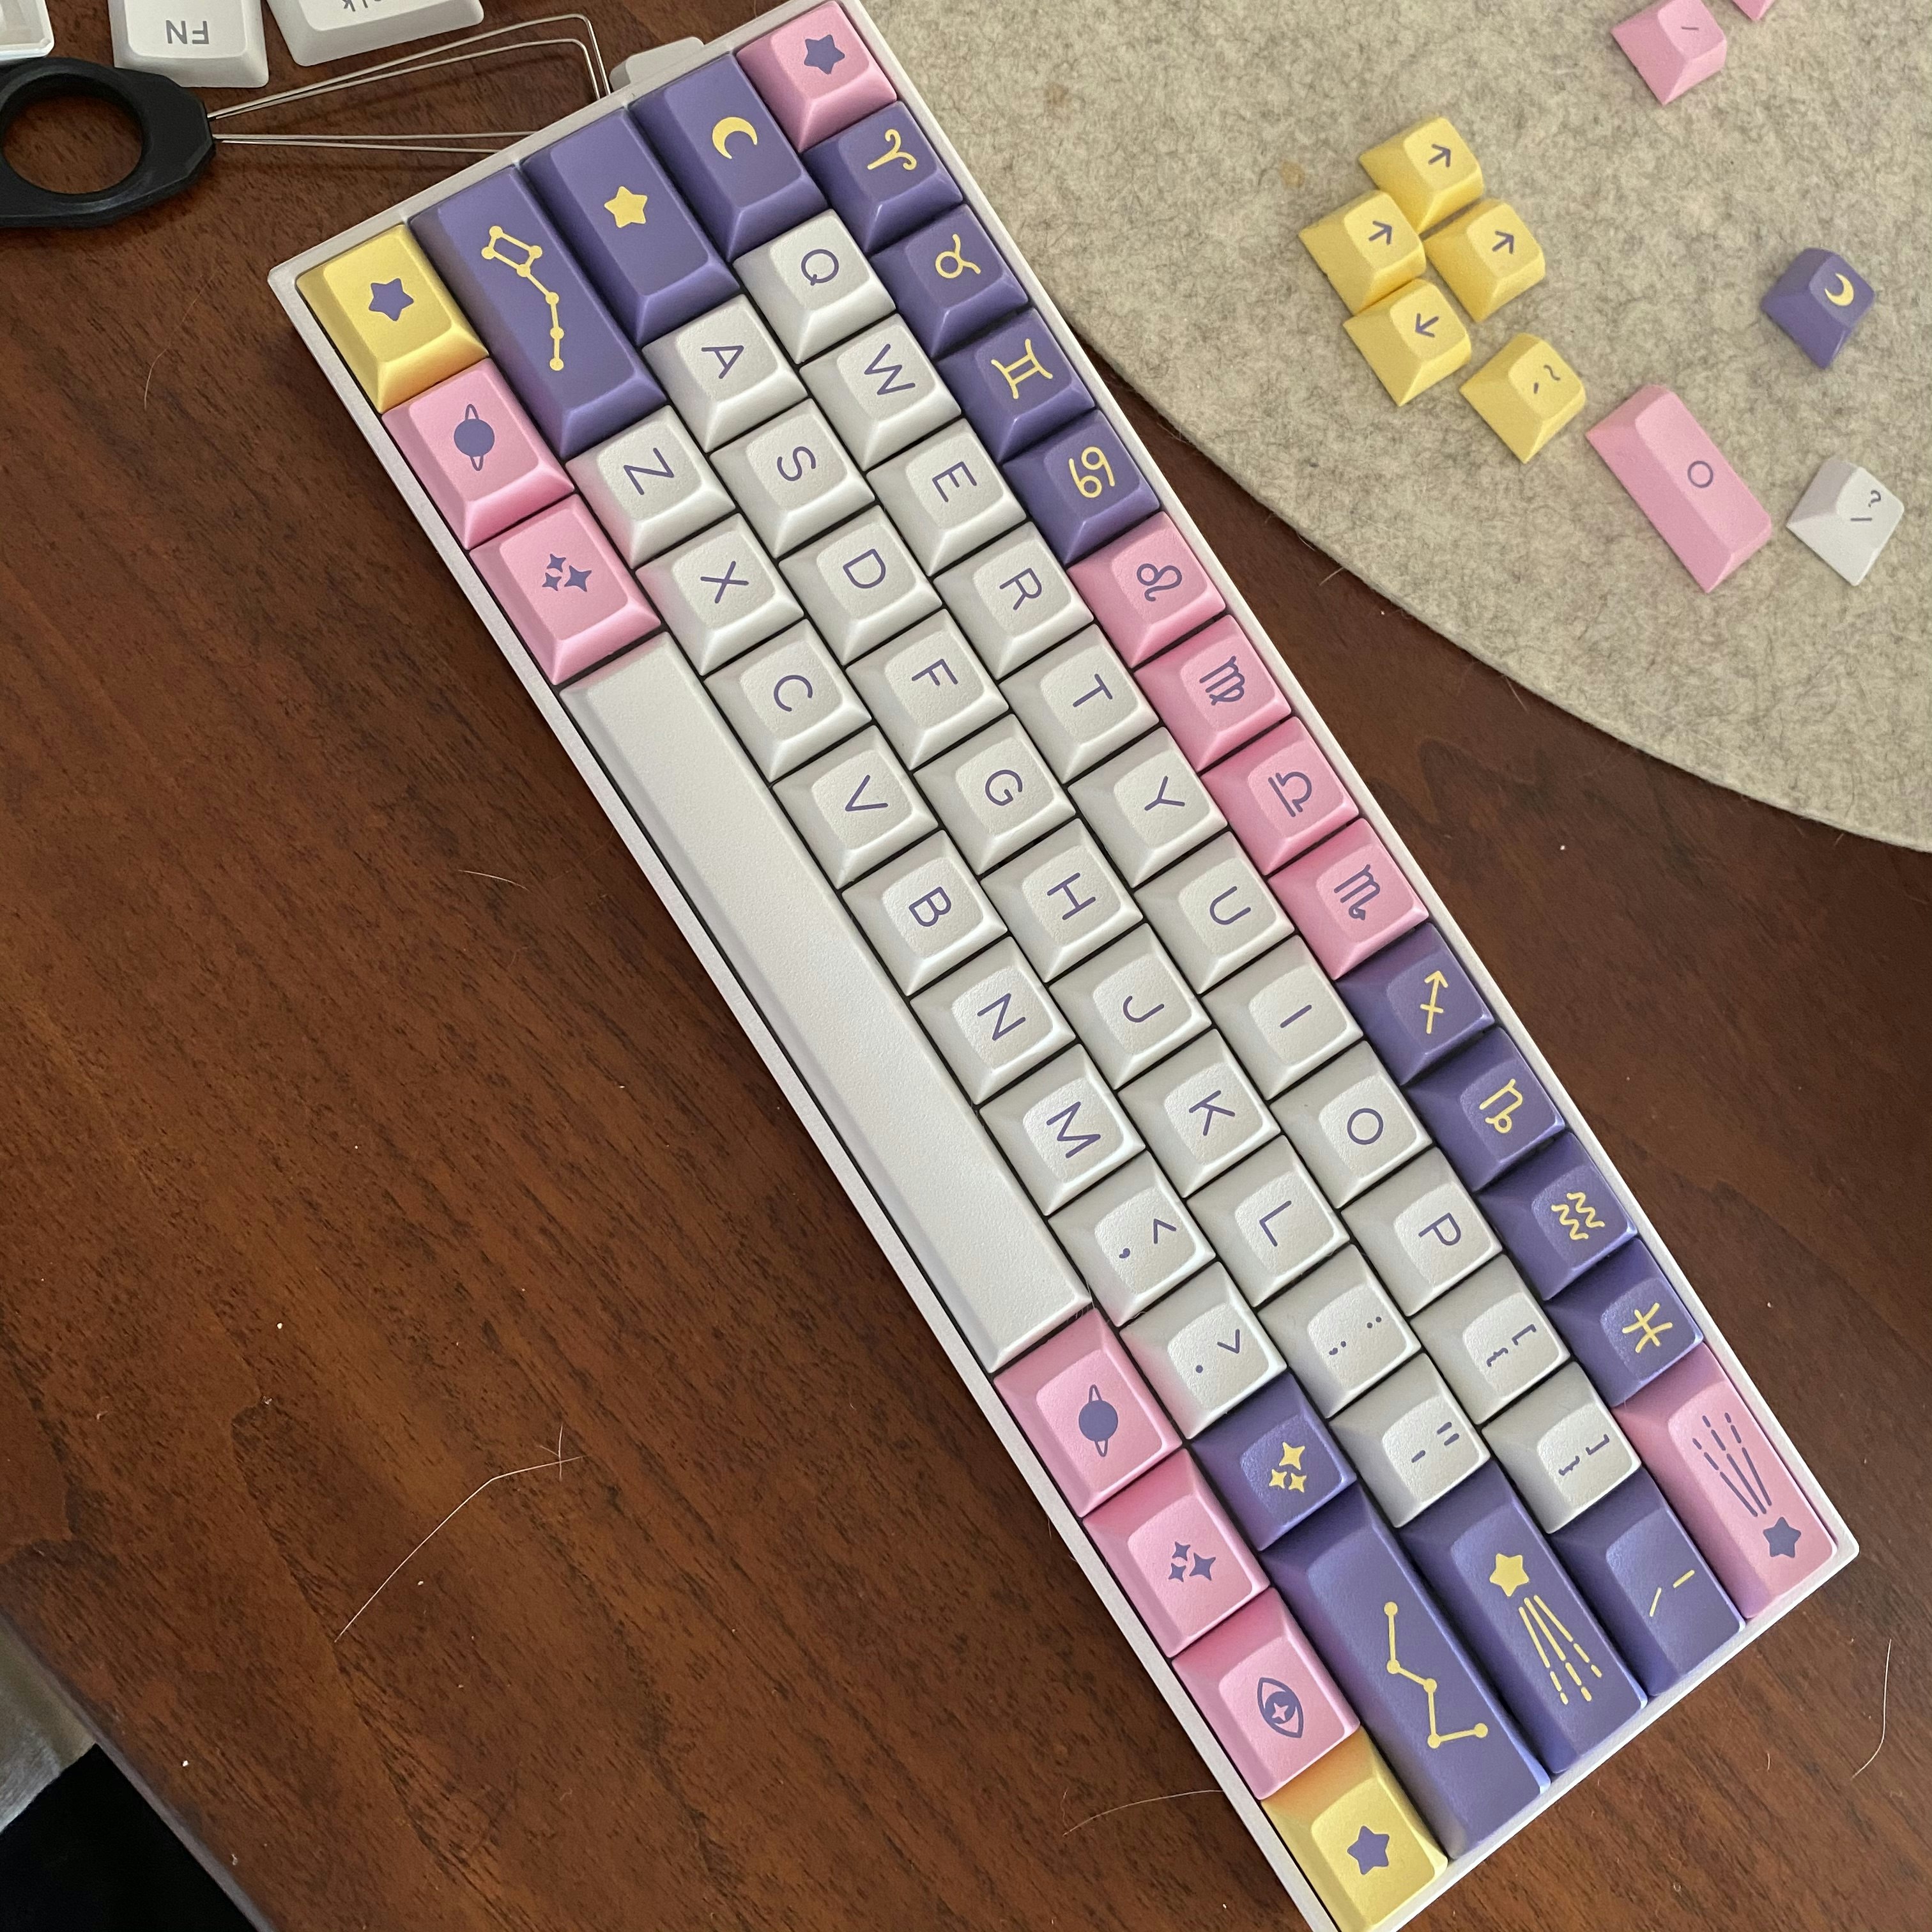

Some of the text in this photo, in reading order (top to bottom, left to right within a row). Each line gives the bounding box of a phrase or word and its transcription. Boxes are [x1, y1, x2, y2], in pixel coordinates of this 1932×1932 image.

[165, 20, 210, 45] FN
[801, 249, 839, 286] Q
[701, 345, 744, 379] A
[863, 343, 916, 397] W
[623, 447, 675, 496] Z
[776, 446, 816, 482] S
[931, 461, 977, 503] E
[700, 560, 749, 604] X
[842, 548, 886, 589] D
[999, 567, 1043, 611] R
[911, 658, 959, 686] F
[1072, 673, 1113, 708] T
[773, 675, 813, 712] C
[845, 774, 889, 812] V
[985, 769, 1023, 806] G
[1144, 775, 1186, 811] Y
[908, 886, 952, 927] B
[1046, 872, 1096, 921] H
[1209, 885, 1252, 926] U
[977, 993, 1026, 1041] N
[1123, 995, 1165, 1023] J
[1046, 1101, 1101, 1159] M
[1188, 1090, 1236, 1137] K
[1347, 1108, 1384, 1146] O
[1259, 1200, 1292, 1247] L
[1418, 1212, 1462, 1246] P
